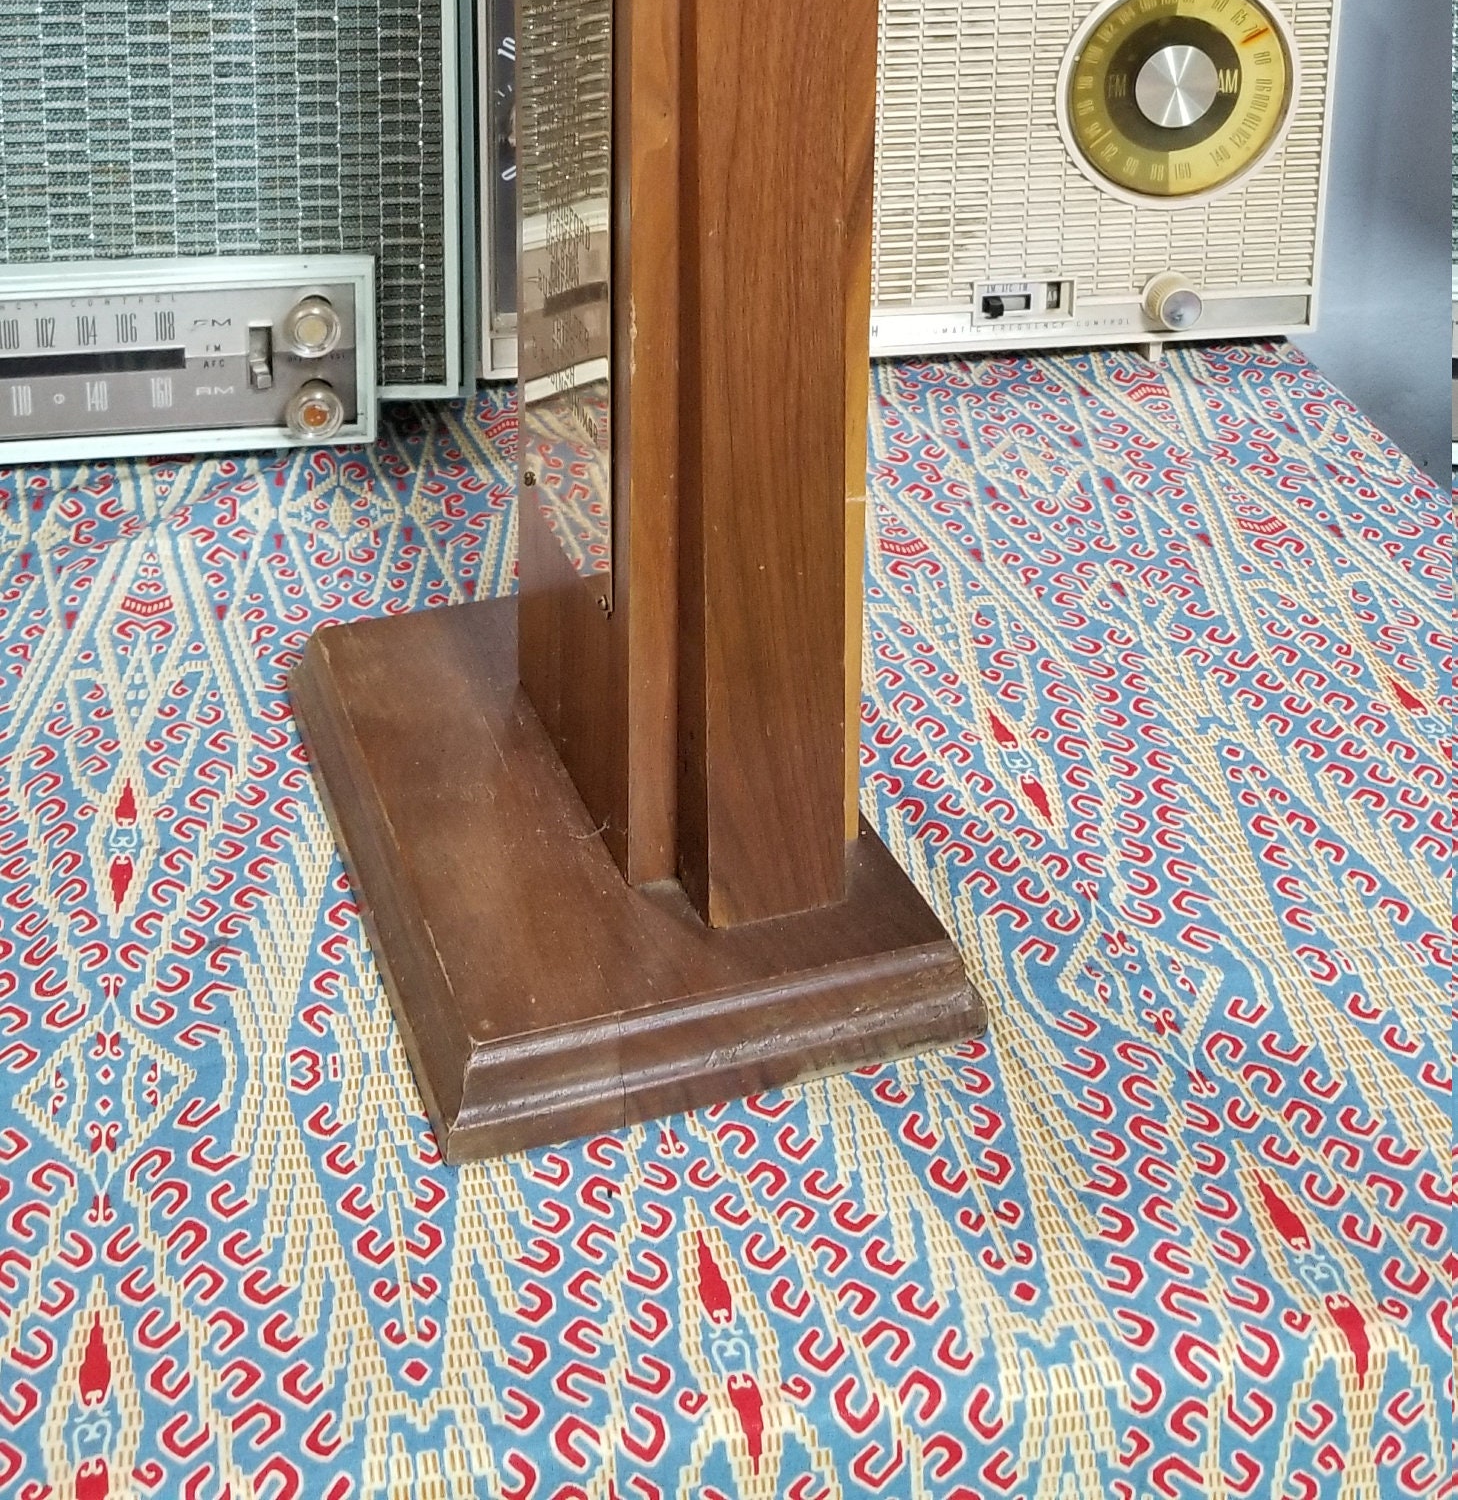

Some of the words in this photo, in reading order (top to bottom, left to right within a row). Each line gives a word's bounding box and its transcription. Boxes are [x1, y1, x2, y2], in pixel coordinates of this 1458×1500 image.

[1231, 8, 1248, 26] 65
[1108, 74, 1127, 98] FM
[1217, 68, 1239, 94] AM
[1209, 145, 1231, 167] 140
[1174, 162, 1192, 181] 160
[36, 317, 56, 349] 102
[76, 315, 98, 346] 104
[115, 312, 138, 344] 106
[154, 311, 175, 341] 108
[193, 317, 232, 328] FM
[203, 359, 226, 369] AFC
[11, 385, 32, 416] 110
[86, 381, 109, 412] 140
[151, 377, 173, 408] 160
[196, 385, 235, 396] AM
